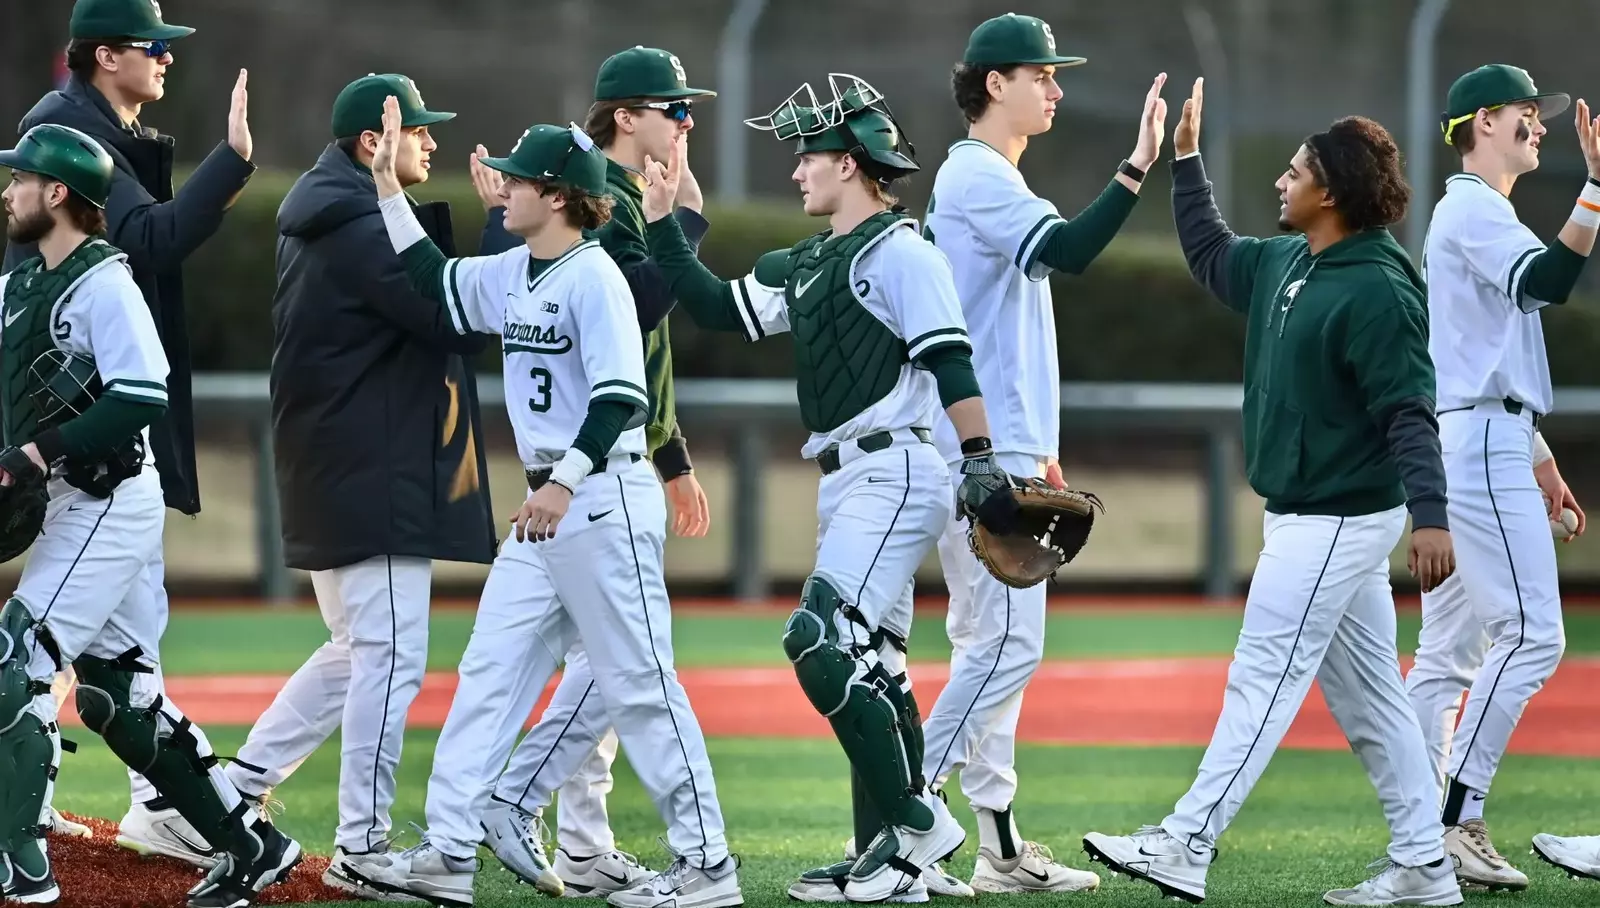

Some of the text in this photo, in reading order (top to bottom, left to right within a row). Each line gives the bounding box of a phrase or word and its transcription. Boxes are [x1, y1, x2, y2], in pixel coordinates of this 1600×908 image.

[1042, 23, 1056, 50] S
[669, 55, 687, 81] S
[528, 367, 552, 413] 3
